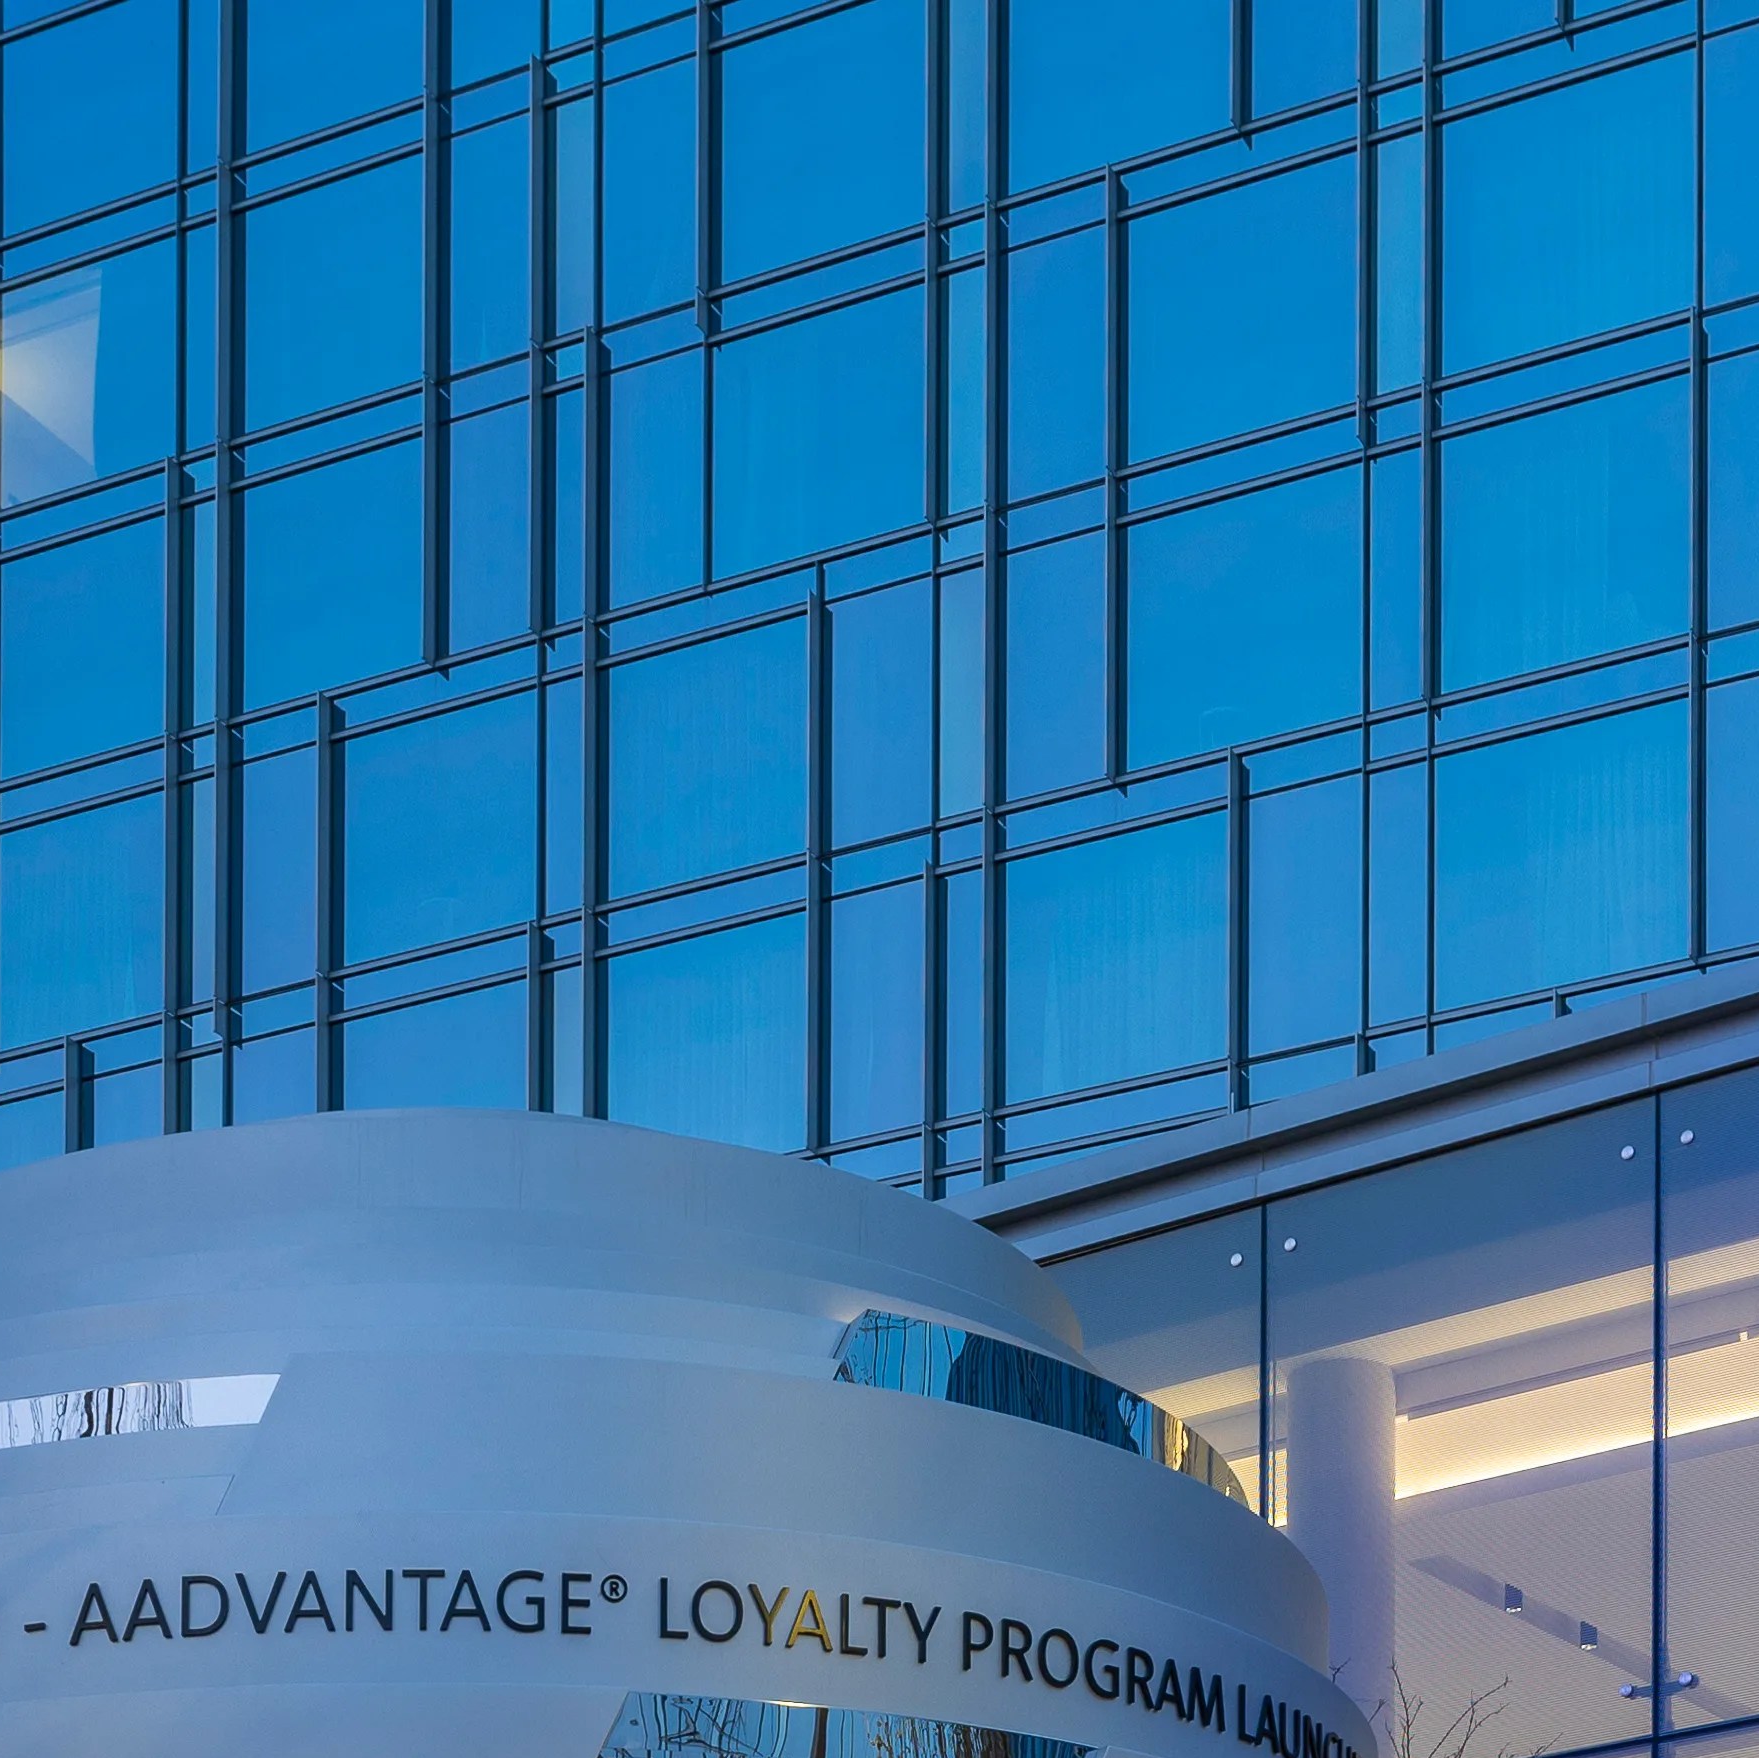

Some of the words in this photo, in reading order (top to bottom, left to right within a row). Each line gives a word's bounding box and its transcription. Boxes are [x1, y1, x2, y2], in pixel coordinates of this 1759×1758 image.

[23, 1622, 48, 1634] -
[658, 1576, 942, 1665] LOYALTY
[961, 1610, 1226, 1735] PROGRAM
